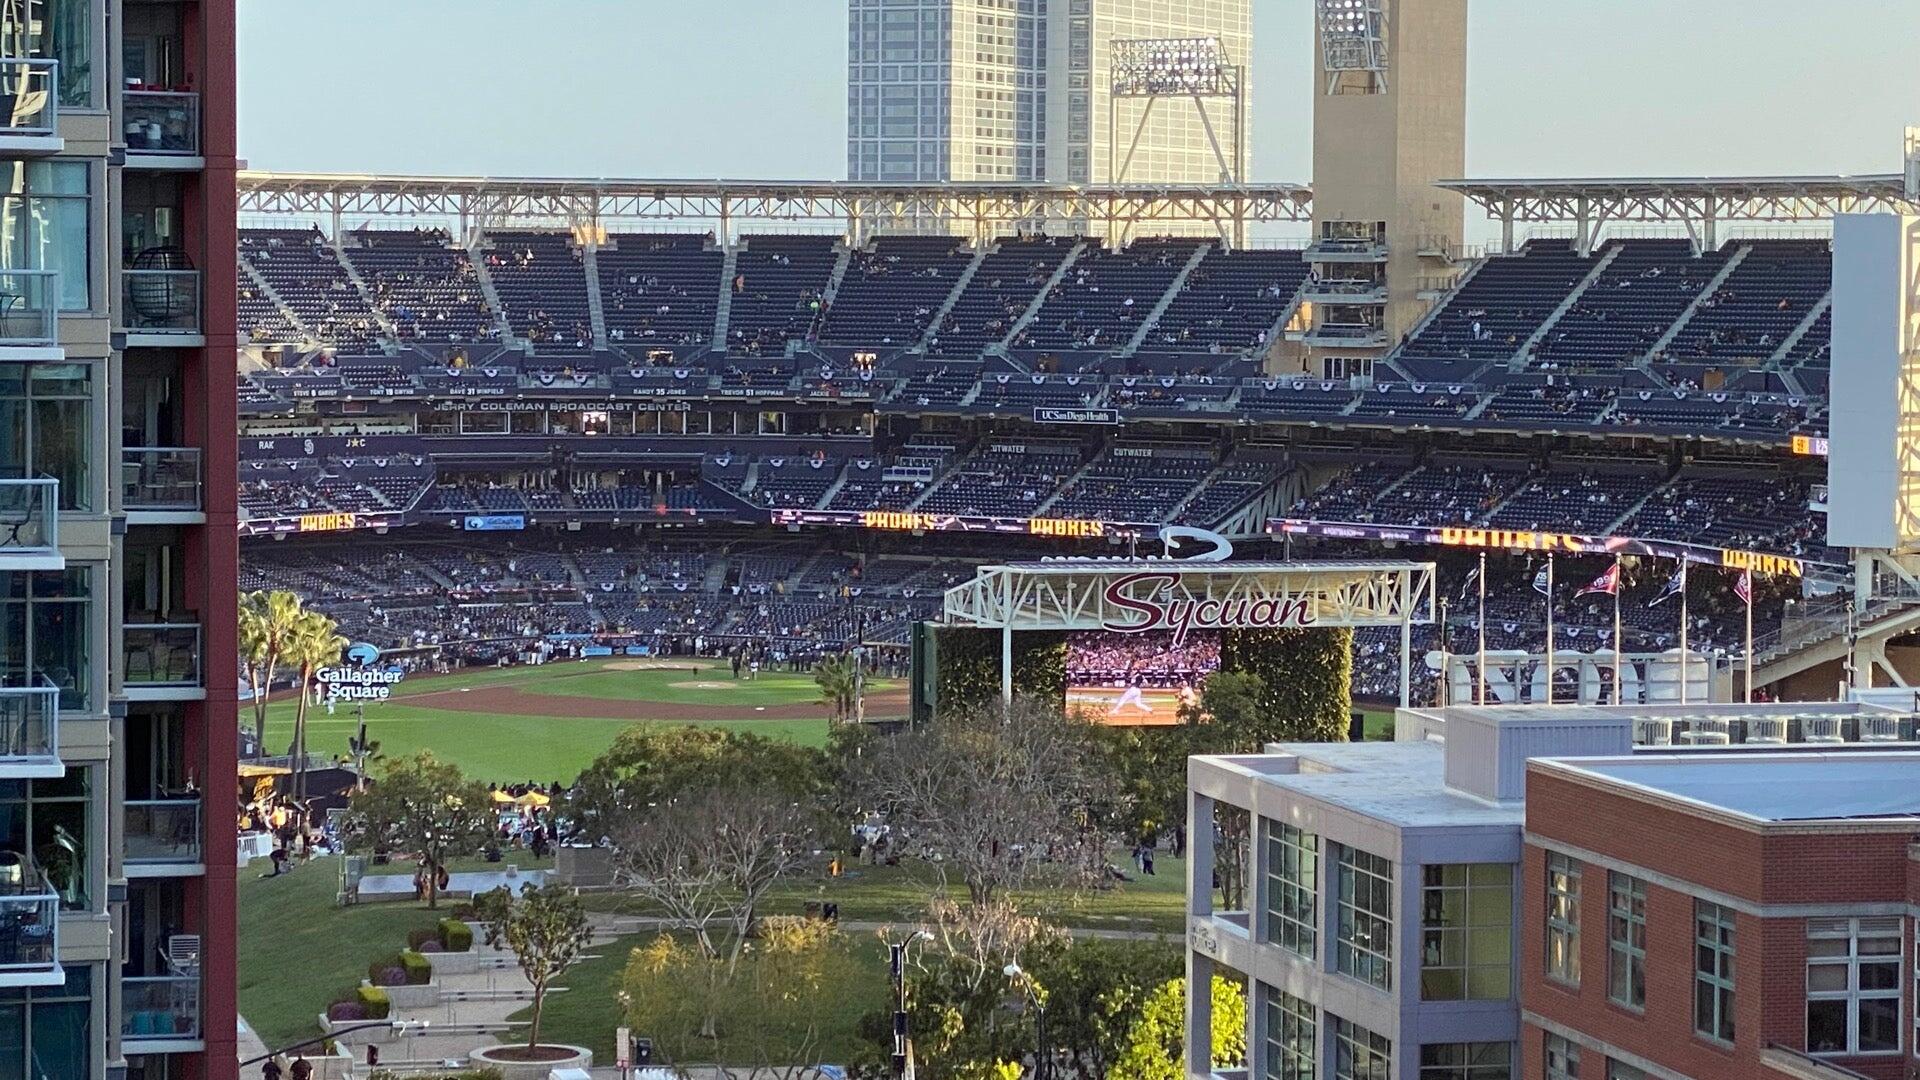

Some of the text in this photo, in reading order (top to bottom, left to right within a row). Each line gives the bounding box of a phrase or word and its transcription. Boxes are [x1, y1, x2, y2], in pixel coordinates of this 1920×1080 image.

[434, 402, 692, 411] JERRY COLEMAN BROADCAST CENTER
[990, 444, 1025, 453] UTWATER
[1101, 571, 1317, 648] Sycuan
[316, 667, 402, 686] Gallagher
[328, 682, 390, 702] Square
